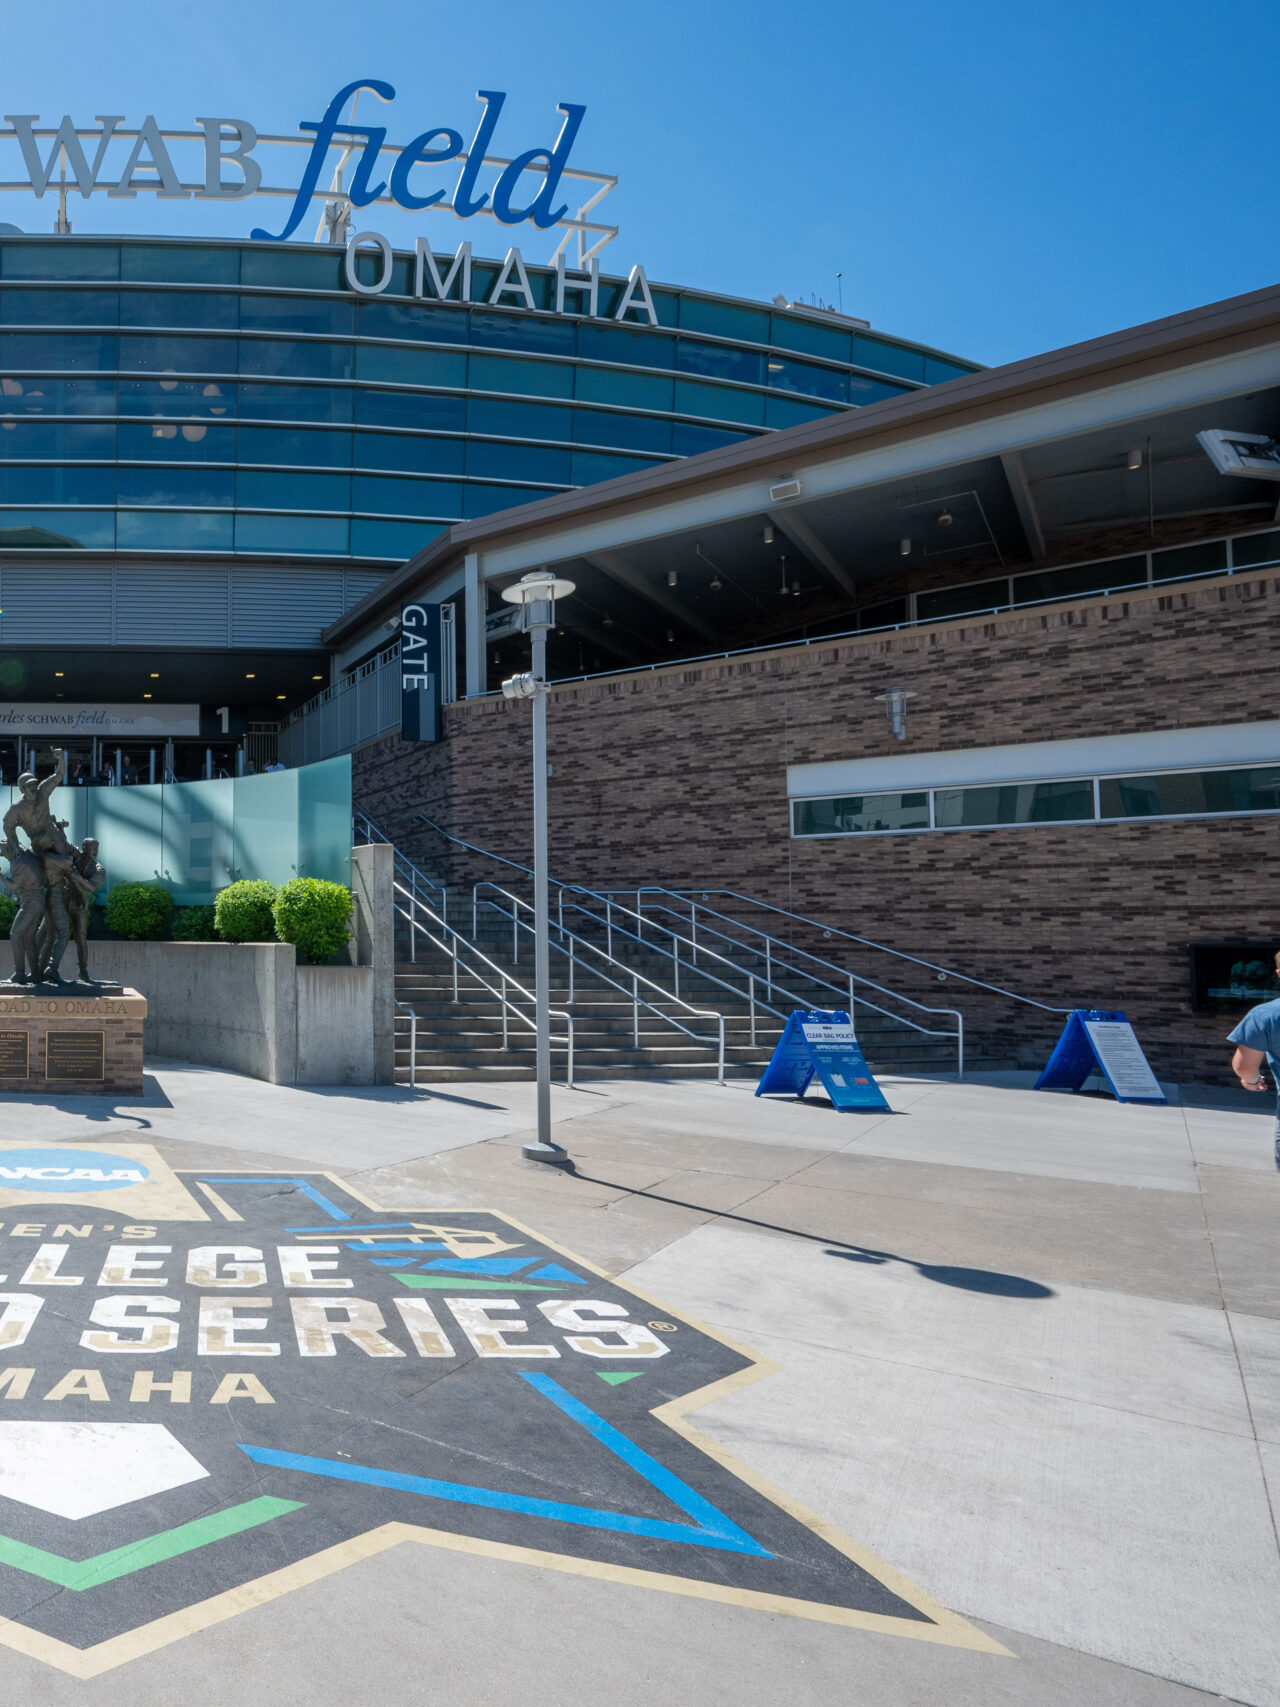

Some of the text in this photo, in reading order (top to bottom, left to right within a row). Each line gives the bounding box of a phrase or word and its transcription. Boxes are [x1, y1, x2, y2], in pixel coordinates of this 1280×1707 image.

[250, 78, 587, 241] field
[344, 231, 658, 327] OMAHA
[402, 605, 428, 690] GATE
[26, 714, 74, 724] SCHWAB
[72, 710, 107, 728] field
[216, 707, 229, 733] 1
[37, 1002, 58, 1013] TO
[65, 1002, 128, 1014] OMAHA
[78, 1294, 672, 1359] SERIES
